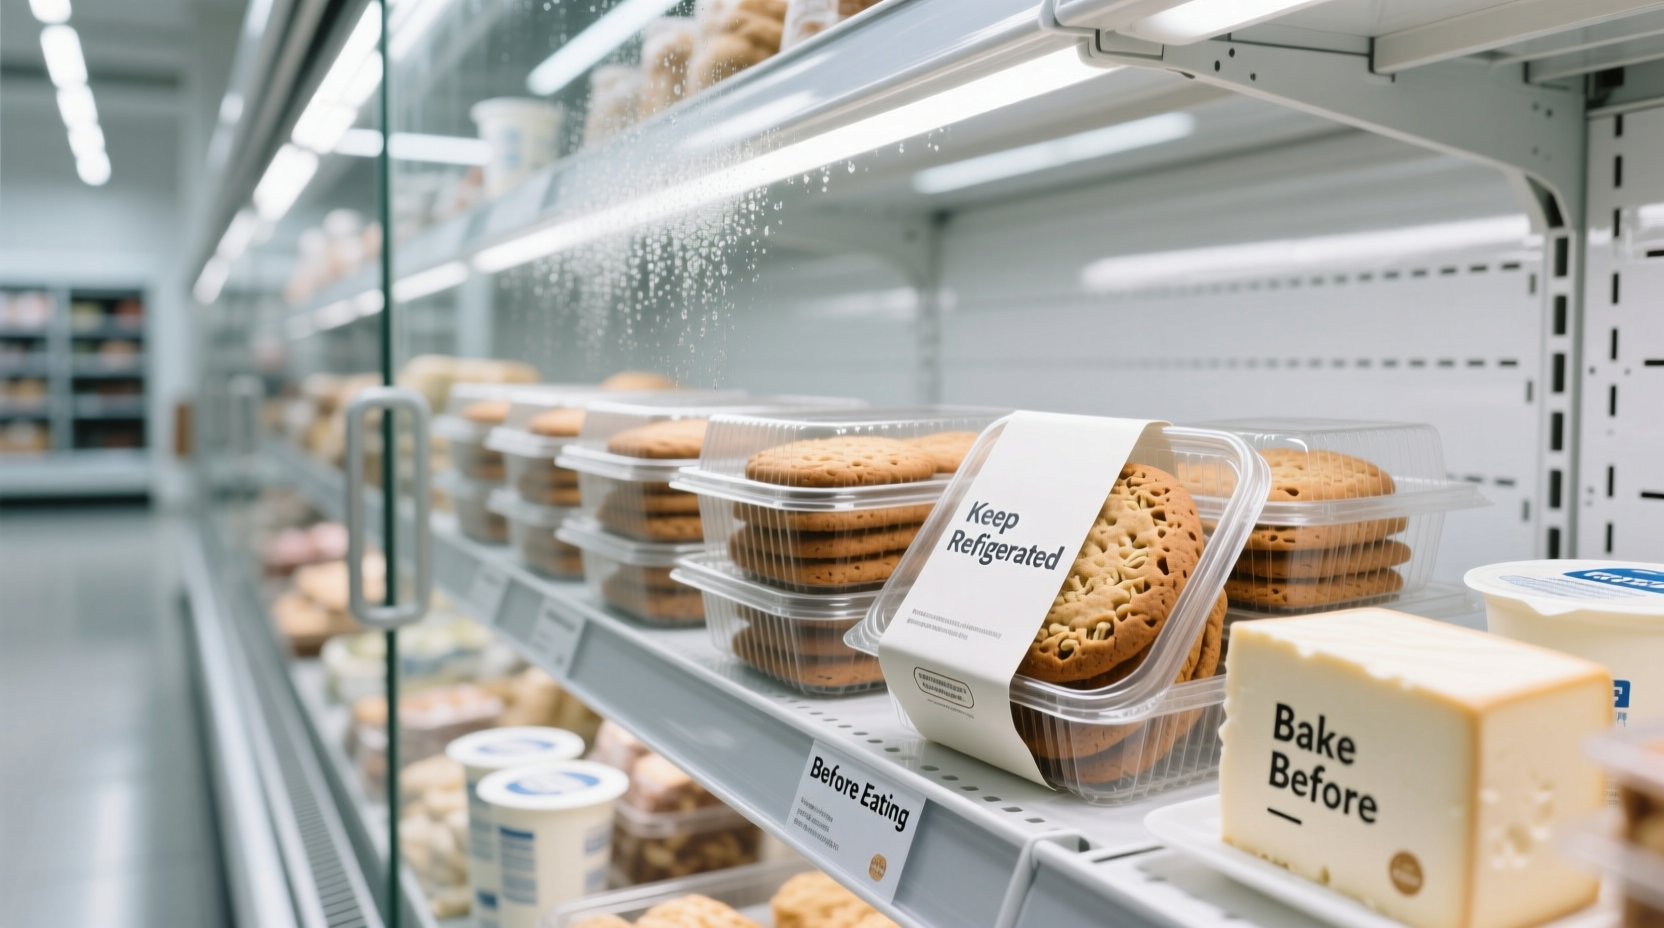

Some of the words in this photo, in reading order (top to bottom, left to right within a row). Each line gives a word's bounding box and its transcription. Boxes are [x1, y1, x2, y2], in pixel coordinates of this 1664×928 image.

[966, 501, 1020, 535] Keep
[947, 529, 1065, 571] Refigerated
[1273, 702, 1356, 765] Bake
[810, 755, 860, 800] Before
[860, 782, 910, 833] Eating
[1268, 750, 1378, 824] Before
